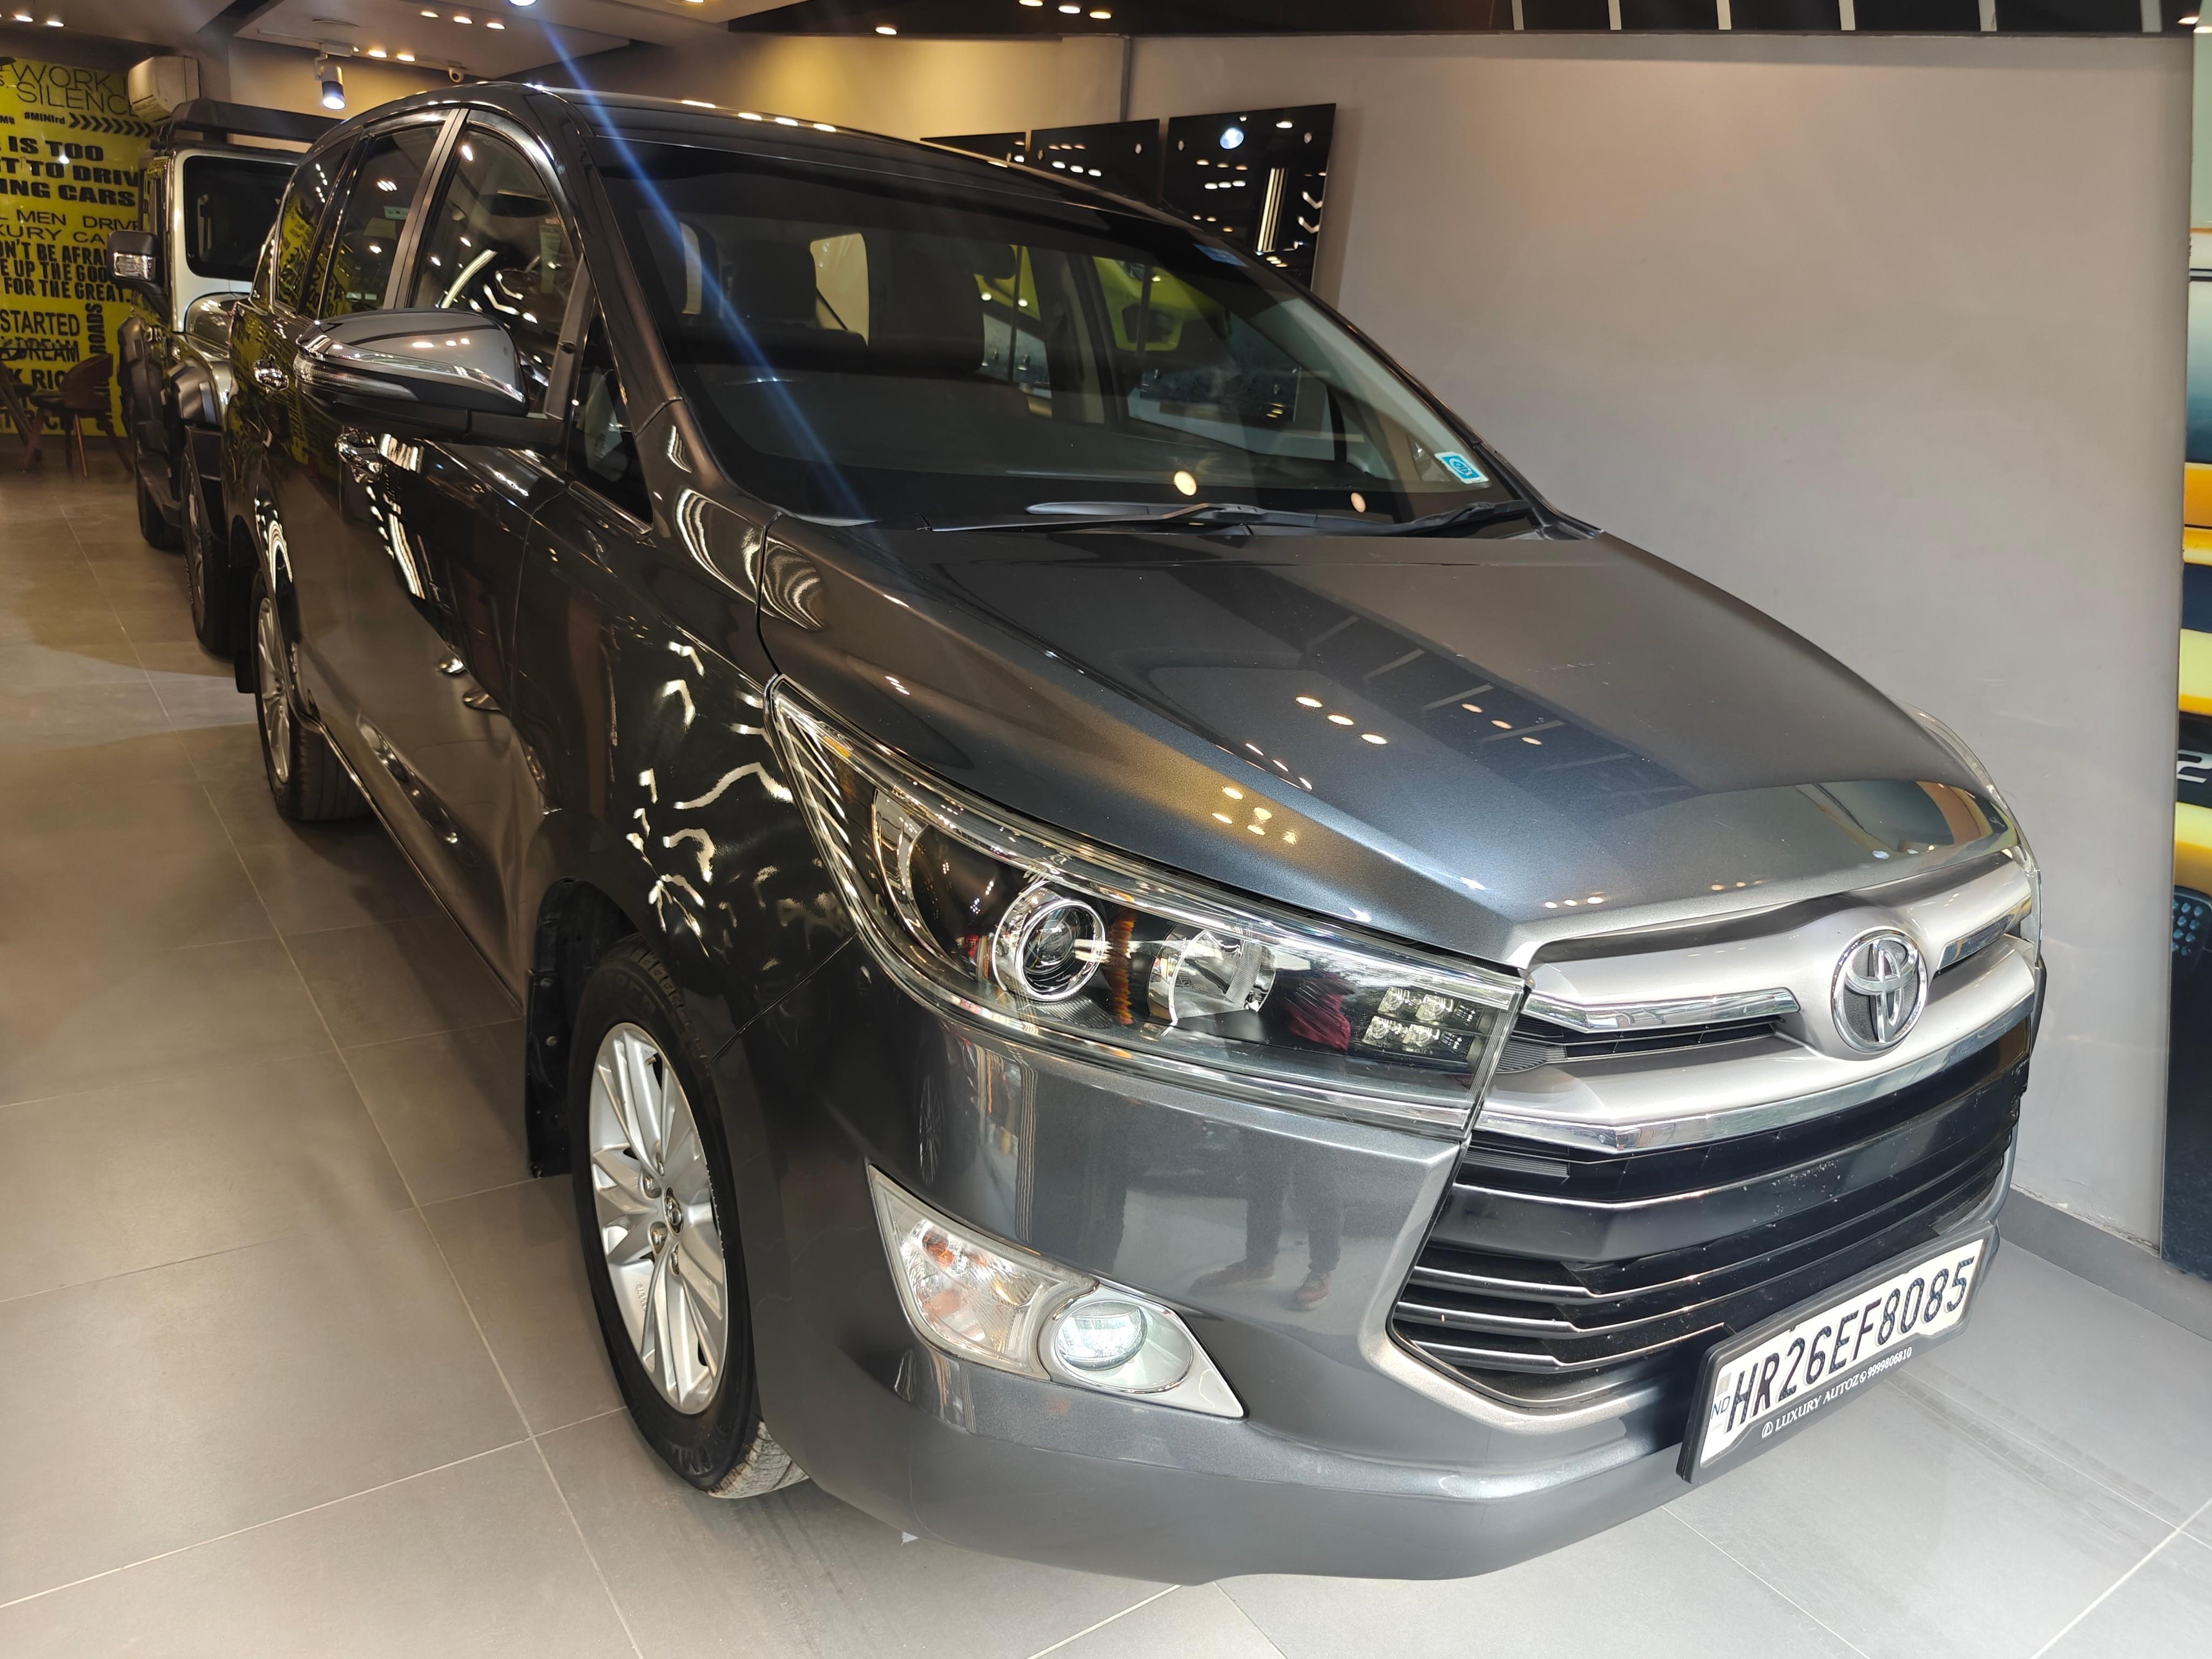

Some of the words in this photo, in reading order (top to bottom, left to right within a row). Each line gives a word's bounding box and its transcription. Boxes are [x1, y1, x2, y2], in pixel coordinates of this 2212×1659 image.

[11, 63, 113, 94] WORK
[8, 136, 39, 154] IS
[45, 140, 104, 161] TOO
[26, 160, 64, 179] TO
[72, 165, 139, 187] DRIV
[58, 185, 136, 207] CARS
[16, 209, 66, 226] MEN
[73, 232, 105, 245] CA
[37, 243, 57, 262] BE
[14, 259, 36, 278] UP
[39, 261, 72, 281] THE
[76, 265, 108, 283] GOO
[4, 277, 36, 296] FOR
[38, 280, 71, 299] THE
[0, 309, 80, 336] STARTED
[1725, 1255, 1976, 1434] HR26EF8085
[1710, 1395, 1731, 1420] ND
[1775, 1395, 1822, 1432] LUXURY
[1822, 1373, 1860, 1405] AUTOZ
